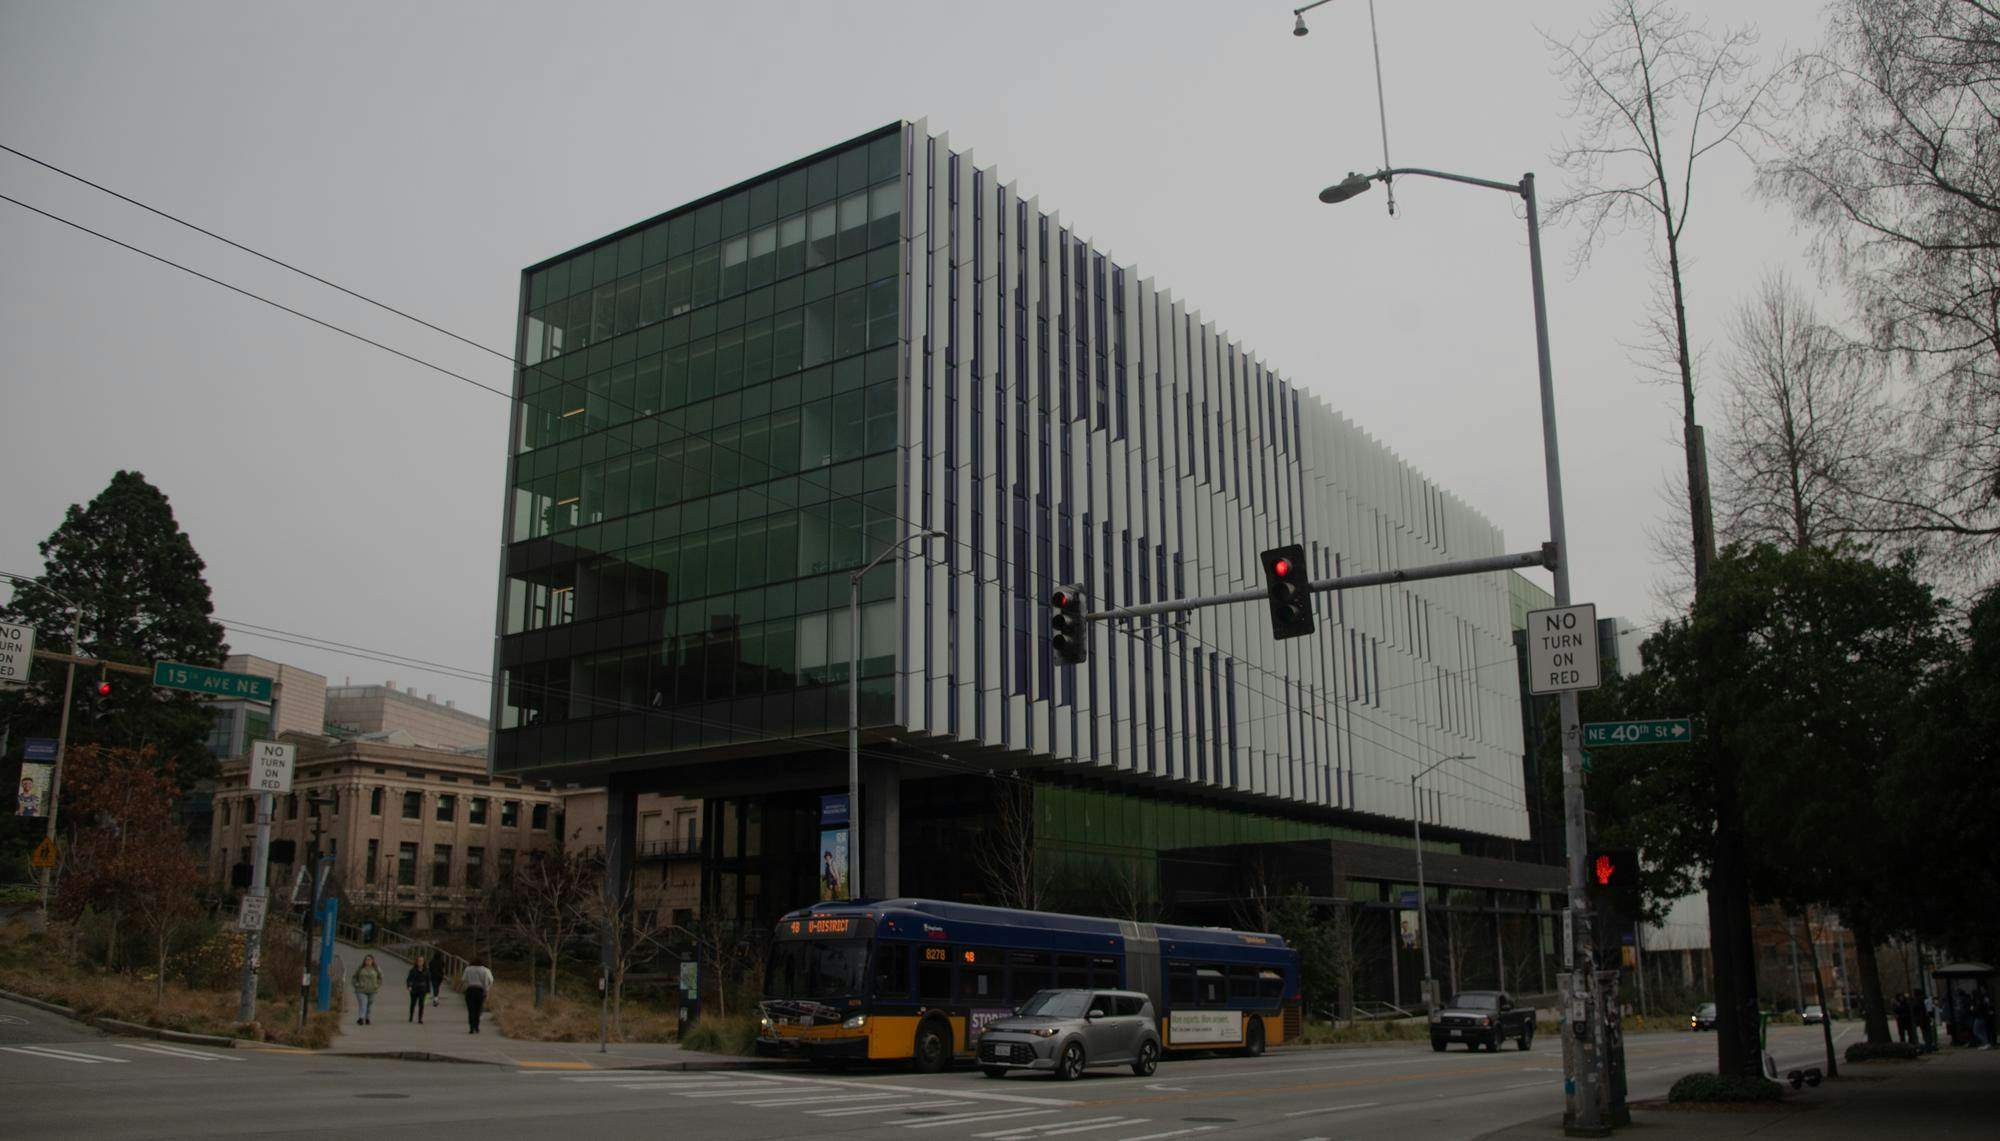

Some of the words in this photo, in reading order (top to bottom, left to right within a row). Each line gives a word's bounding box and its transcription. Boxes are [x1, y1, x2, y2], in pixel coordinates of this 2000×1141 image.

[1546, 612, 1576, 631] NO
[0, 629, 21, 640] NO
[0, 641, 22, 653] URN
[1542, 633, 1582, 650] TURN
[1553, 653, 1573, 667] ON
[0, 665, 15, 676] ED
[1550, 670, 1579, 686] RED
[203, 676, 230, 690] AVE
[237, 679, 260, 695] NE
[1588, 728, 1606, 740] NE
[1610, 725, 1649, 741] 40th
[1654, 725, 1668, 738] St
[264, 745, 284, 757] NO
[261, 758, 286, 768] TURN
[265, 769, 278, 778] ON
[261, 779, 281, 789] RED
[808, 919, 849, 934] U-DISTRICT
[925, 948, 946, 961] 8278
